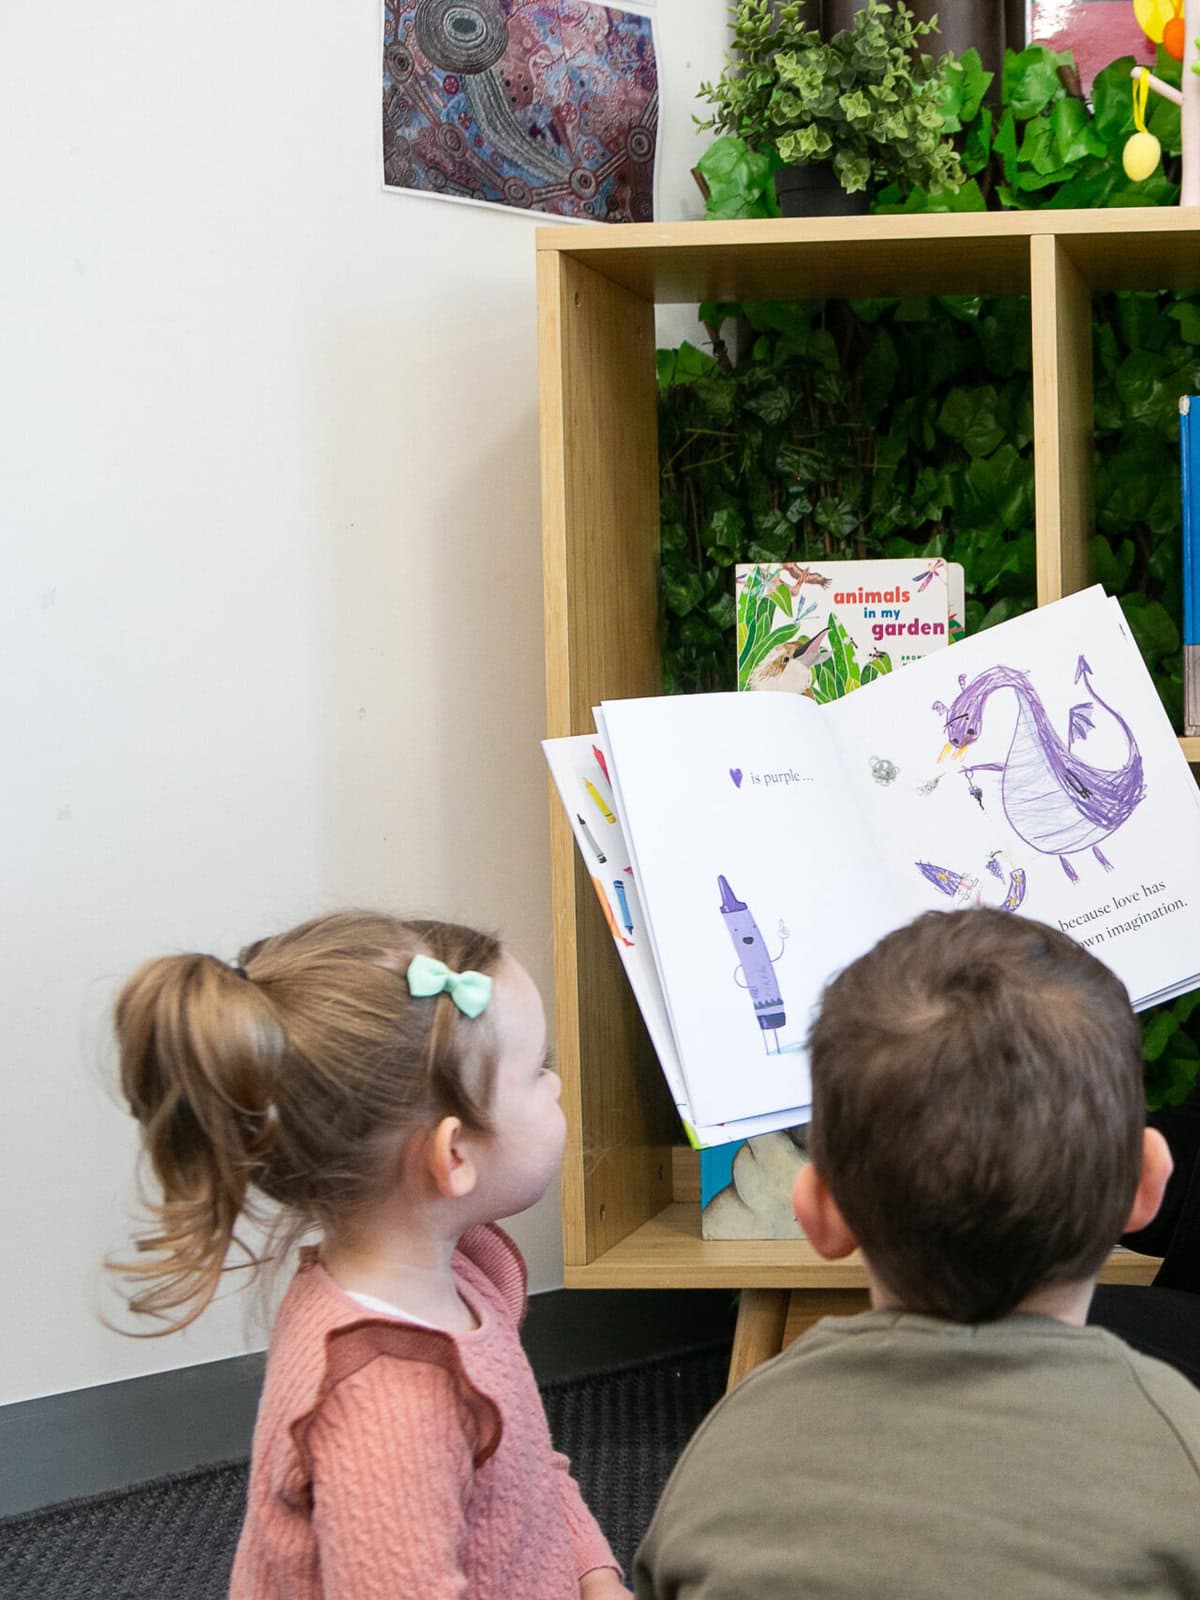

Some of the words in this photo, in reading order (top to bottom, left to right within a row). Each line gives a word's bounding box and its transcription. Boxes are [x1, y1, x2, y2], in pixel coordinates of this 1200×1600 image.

[833, 586, 911, 605] animals
[864, 606, 876, 619] in
[881, 608, 901, 621] my
[872, 618, 945, 641] garden
[750, 771, 761, 785] is
[1058, 902, 1111, 933] because
[1112, 890, 1140, 910] love
[1141, 880, 1167, 898] has
[1106, 896, 1188, 938] imagination.
